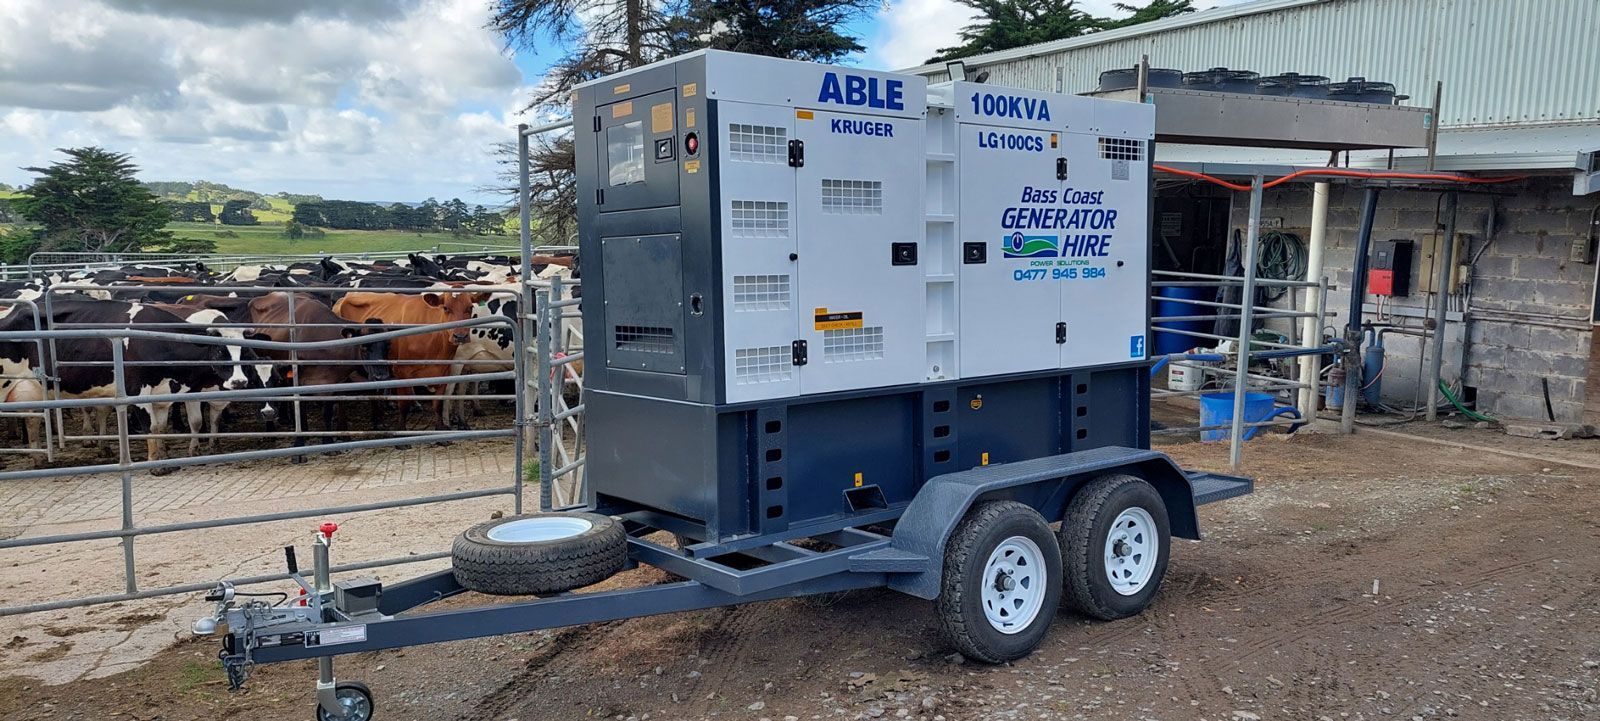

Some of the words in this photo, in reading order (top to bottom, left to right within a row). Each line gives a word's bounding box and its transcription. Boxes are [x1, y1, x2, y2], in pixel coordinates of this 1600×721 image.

[818, 72, 904, 111] ABLE
[971, 92, 1050, 121] 100KVA
[831, 118, 894, 137] KRUGER
[979, 132, 1043, 152] LG100CS
[1021, 186, 1057, 204] Bass
[1063, 187, 1104, 205] Coast
[1001, 207, 1118, 229] GENERATOR
[1061, 234, 1113, 257] HIRE
[1013, 269, 1047, 281] 0477
[1052, 268, 1077, 280] 945
[1082, 267, 1106, 279] 984
[1136, 337, 1143, 356] f
